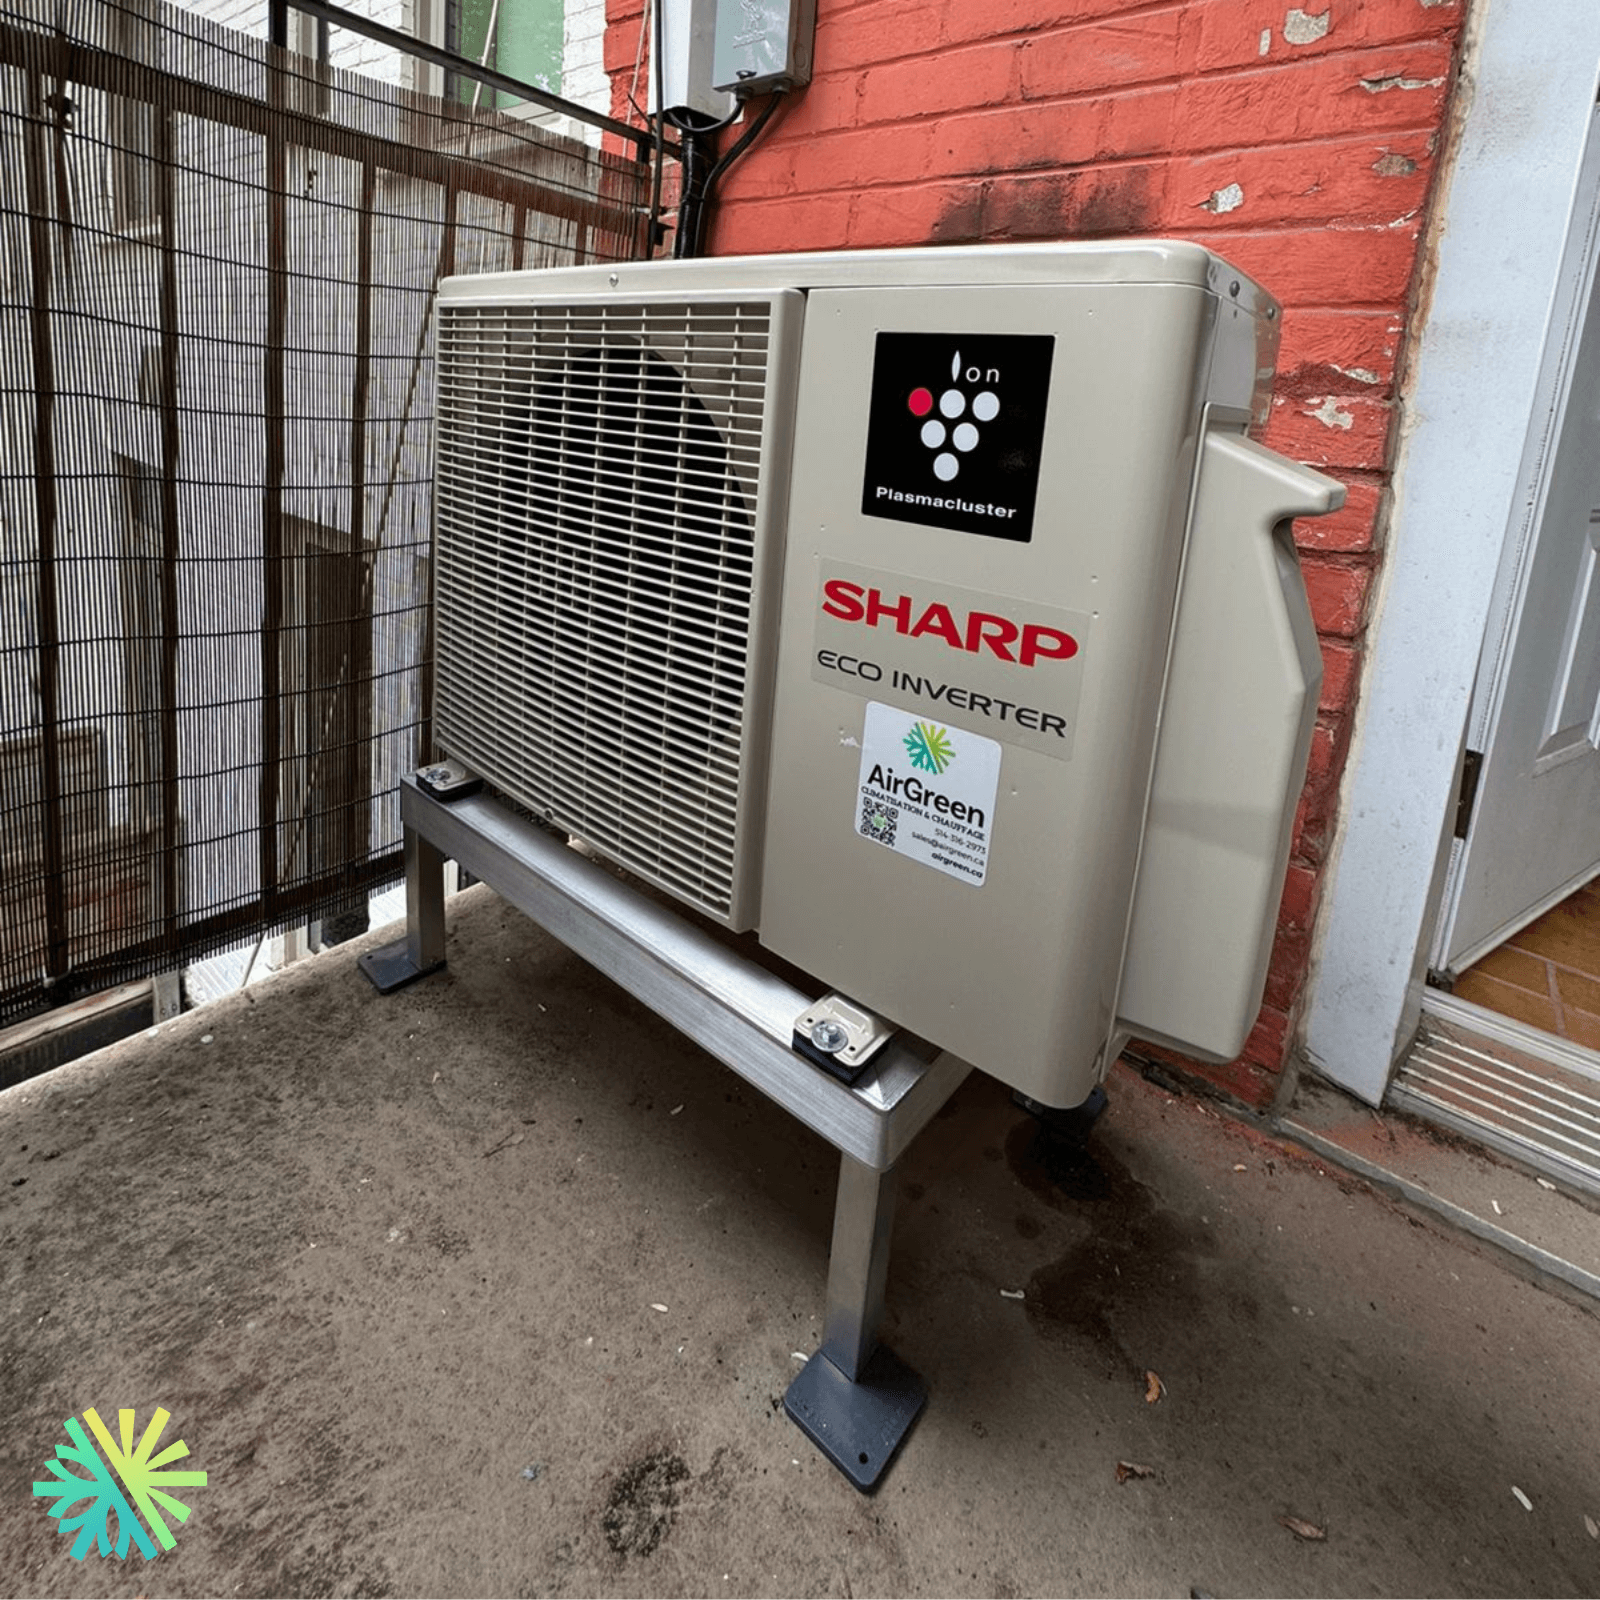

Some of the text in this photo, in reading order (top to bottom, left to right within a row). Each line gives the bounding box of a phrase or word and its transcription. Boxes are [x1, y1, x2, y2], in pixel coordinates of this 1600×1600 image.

[876, 486, 1017, 519] Plasmacluster
[822, 579, 1079, 667] SHARP
[817, 650, 1067, 738] ECO INVERTER
[861, 786, 923, 816] CLIMATISATION
[931, 814, 985, 841] CHAUFFAGE
[867, 764, 985, 828] AirGreen
